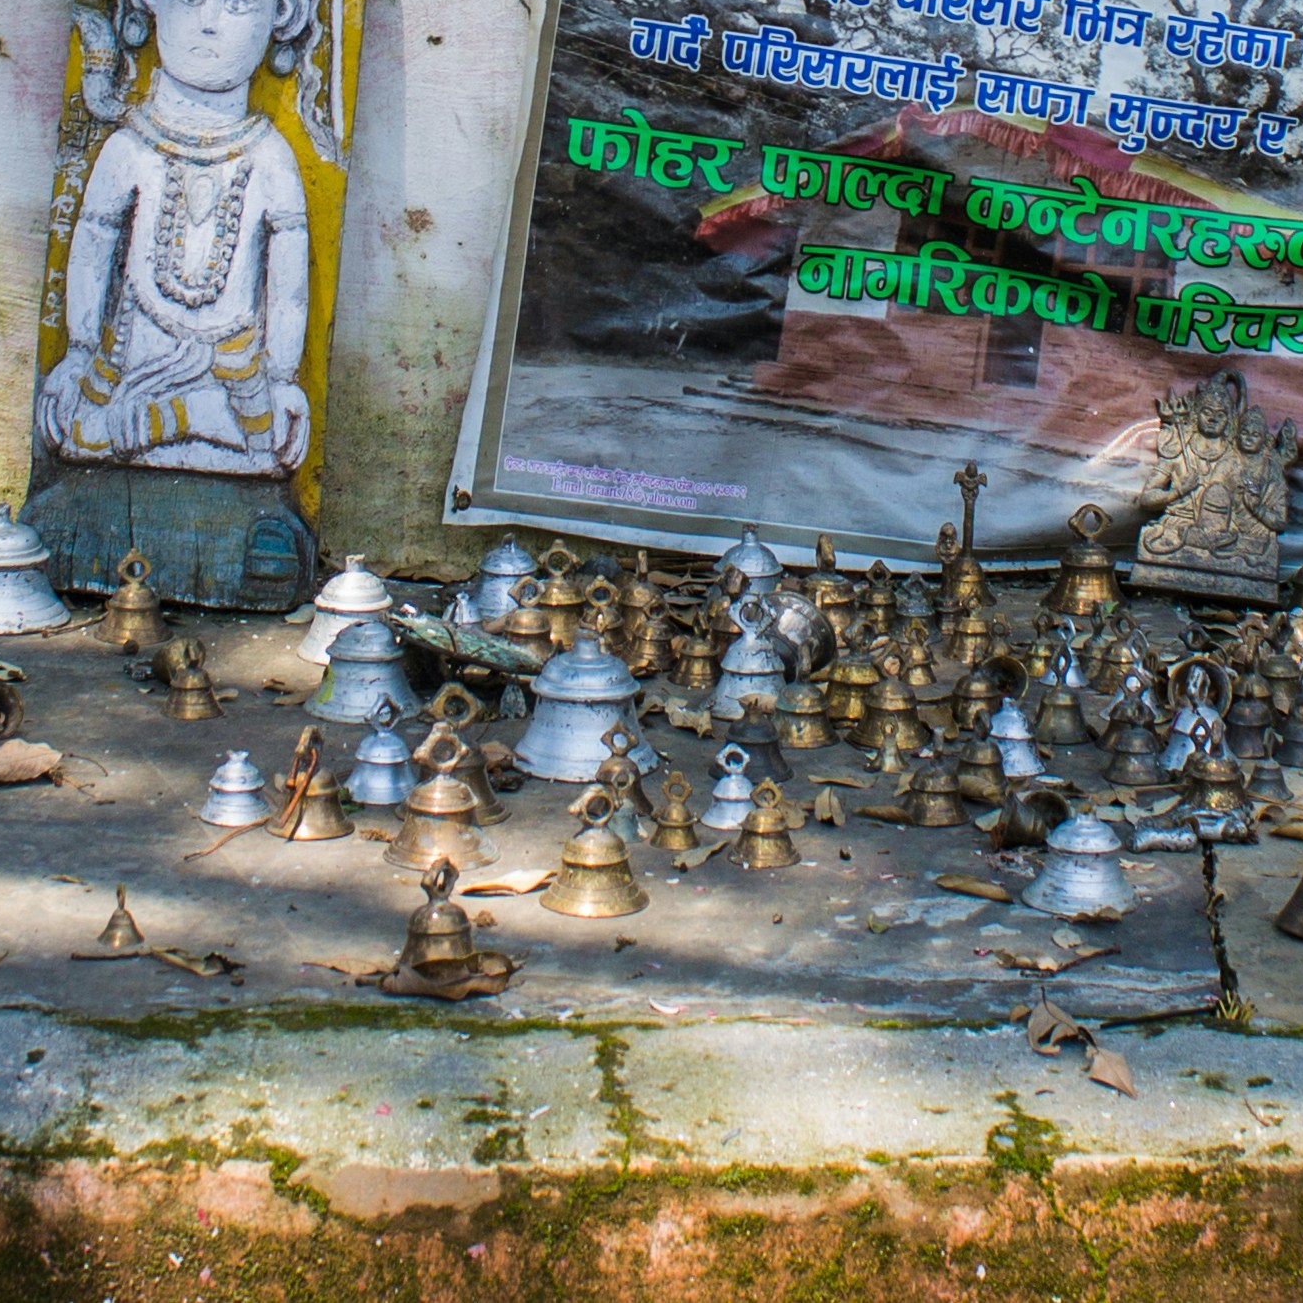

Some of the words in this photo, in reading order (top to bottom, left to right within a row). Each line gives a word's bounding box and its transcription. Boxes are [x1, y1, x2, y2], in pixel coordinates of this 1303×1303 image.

[1166, 11, 1295, 70] रहेका
[722, 25, 965, 114] परिसरलाई
[976, 70, 1095, 126] सफा
[1107, 92, 1248, 155] सुन्दर
[1257, 113, 1297, 156] र
[567, 108, 744, 194] फोहर
[760, 144, 955, 217] फाल्दा
[799, 240, 1118, 330] नागरिकको
